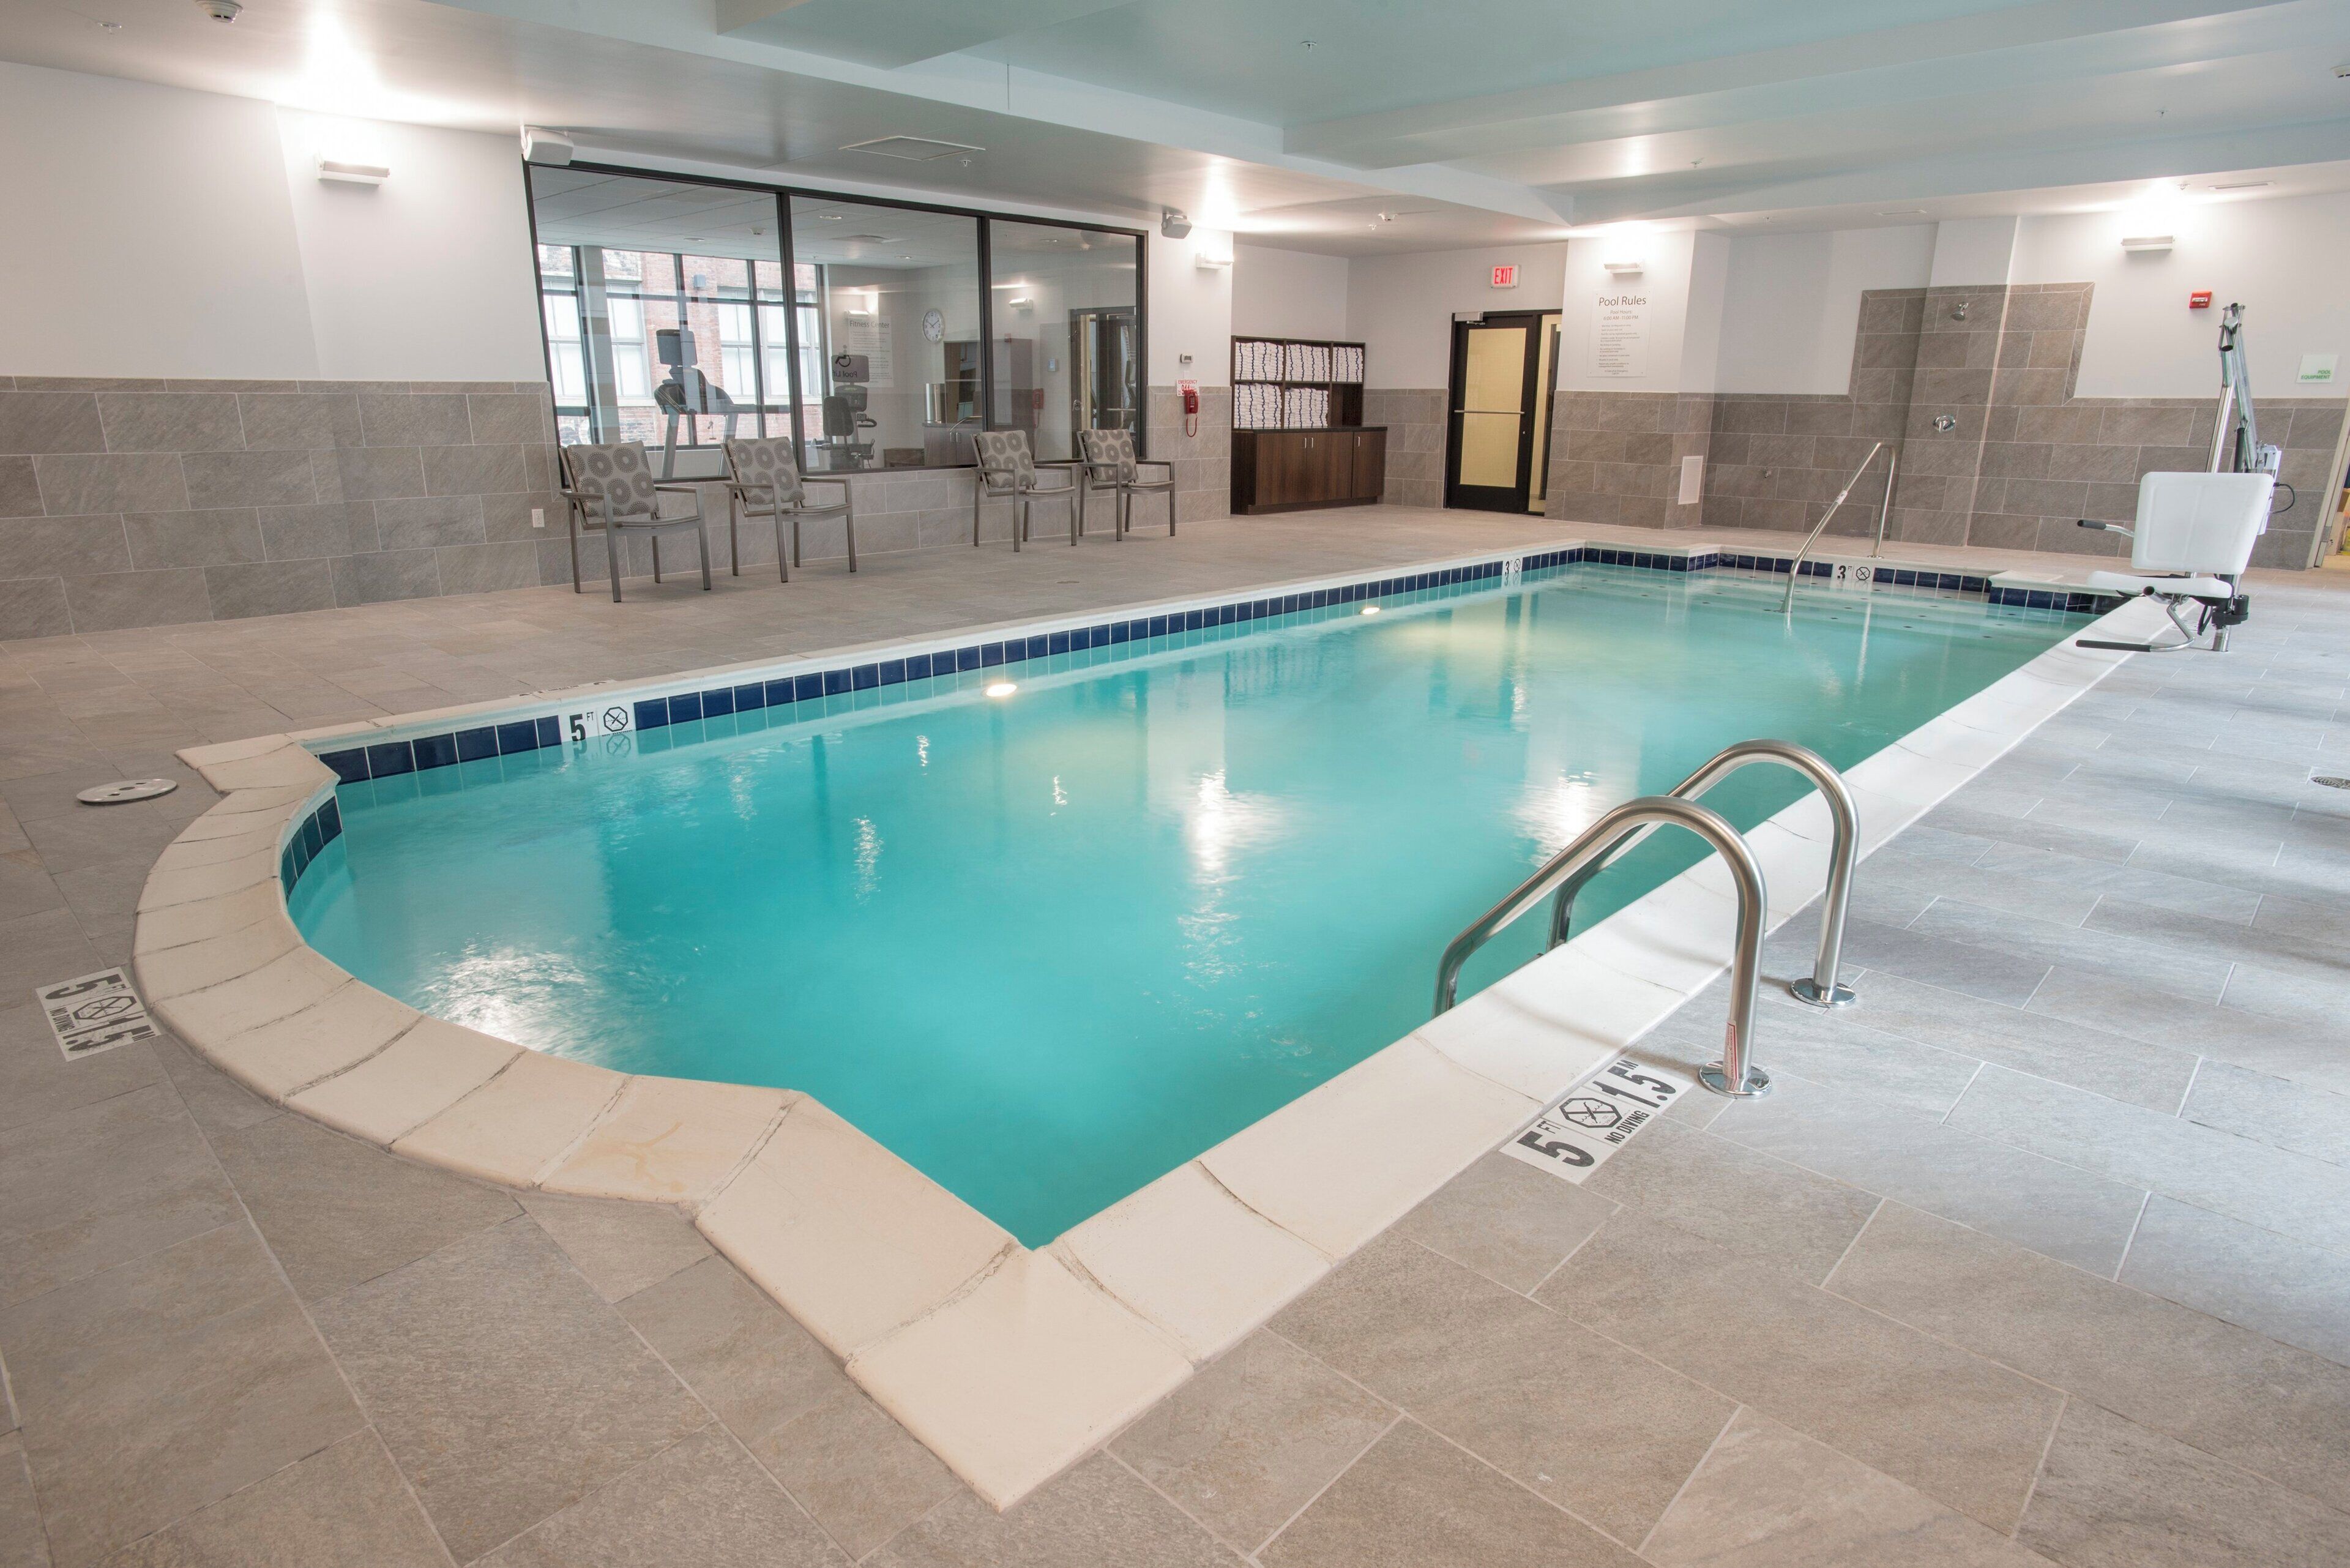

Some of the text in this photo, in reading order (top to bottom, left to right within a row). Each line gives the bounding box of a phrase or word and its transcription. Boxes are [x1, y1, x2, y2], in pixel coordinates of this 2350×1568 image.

[1494, 267, 1513, 284] EXIT
[1598, 295, 1646, 306] Pool Rules
[1505, 561, 1510, 575] 3
[1837, 565, 1846, 579] 3
[569, 712, 594, 742] 5 FT
[45, 974, 123, 1000] 5
[50, 1007, 75, 1033] NO DIVING
[1592, 1059, 1677, 1109] 1.5 M
[1604, 1131, 1626, 1144] NO
[1616, 1110, 1651, 1135] DIVING
[1516, 1120, 1595, 1168] 5 FT
